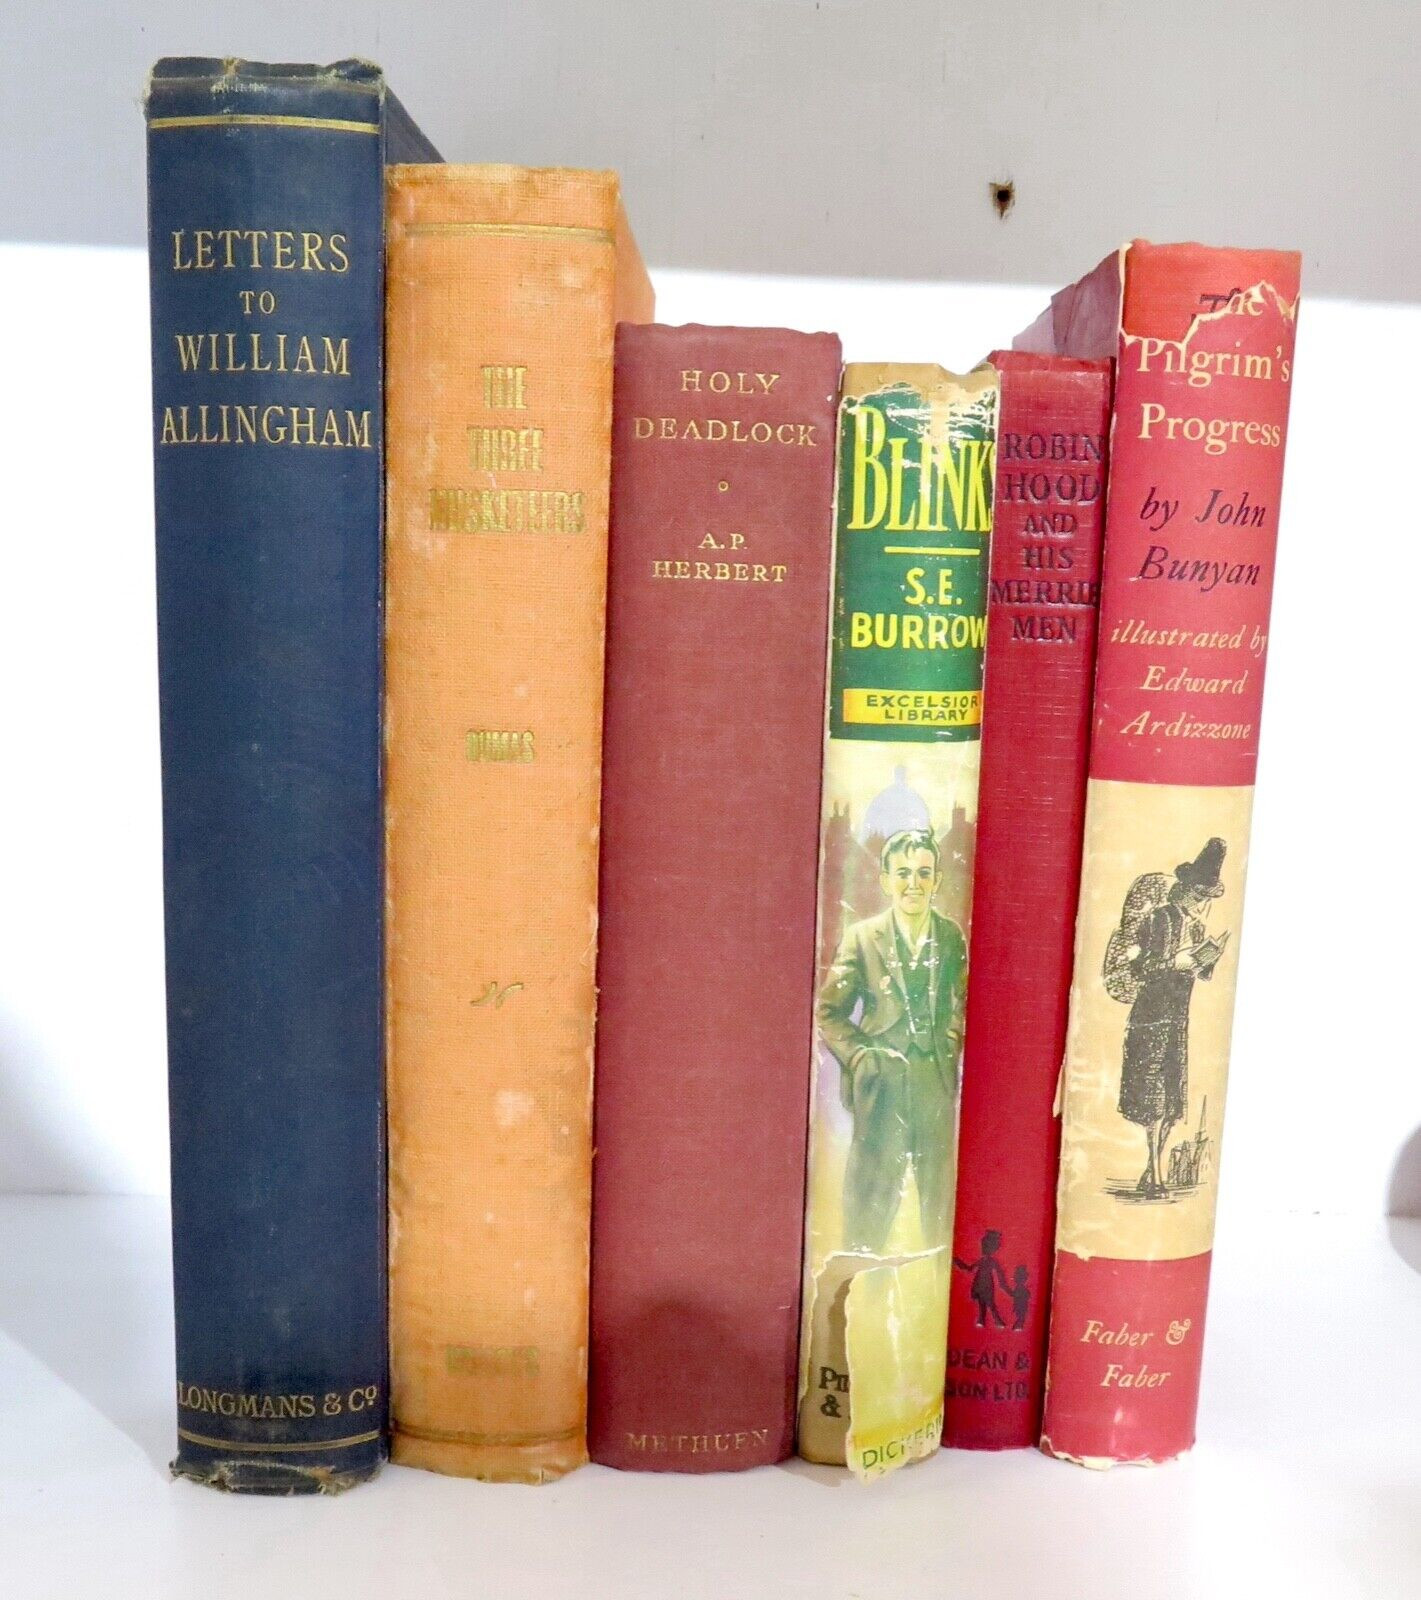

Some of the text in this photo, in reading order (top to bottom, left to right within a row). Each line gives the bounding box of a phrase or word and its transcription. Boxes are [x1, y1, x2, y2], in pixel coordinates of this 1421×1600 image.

[172, 229, 349, 273] LETTERS
[239, 290, 275, 315] TO
[175, 333, 350, 376] WILLIAM
[1136, 337, 1291, 388] Pilgrim's
[480, 365, 528, 410] THE
[681, 370, 780, 394] HOLY
[160, 405, 372, 448] ALLINGHAM
[634, 417, 817, 447] DEADLOCK
[1138, 403, 1281, 456] Progress
[1004, 433, 1104, 462] ROBIN
[1004, 473, 1102, 503] HOOD
[1140, 486, 1266, 532] by John
[1023, 513, 1077, 537] AND
[652, 560, 787, 583] HERBERT
[1023, 547, 1074, 570] HIS
[1138, 546, 1261, 592] Bunyan
[1012, 615, 1076, 642] MEN
[1111, 619, 1268, 658] illustrated by
[1139, 665, 1249, 695] Edward
[866, 693, 978, 709] EXCELSIOR
[885, 708, 968, 721] LIBRARY
[1119, 710, 1251, 740] Ardizzone
[1080, 1318, 1192, 1347] Faber &
[1015, 1351, 1029, 1370] &
[1100, 1363, 1171, 1388] Faber
[177, 1381, 317, 1419] LONGMANS
[323, 1393, 342, 1416] &
[820, 1394, 842, 1418] &
[625, 1429, 769, 1453] METHUEN
